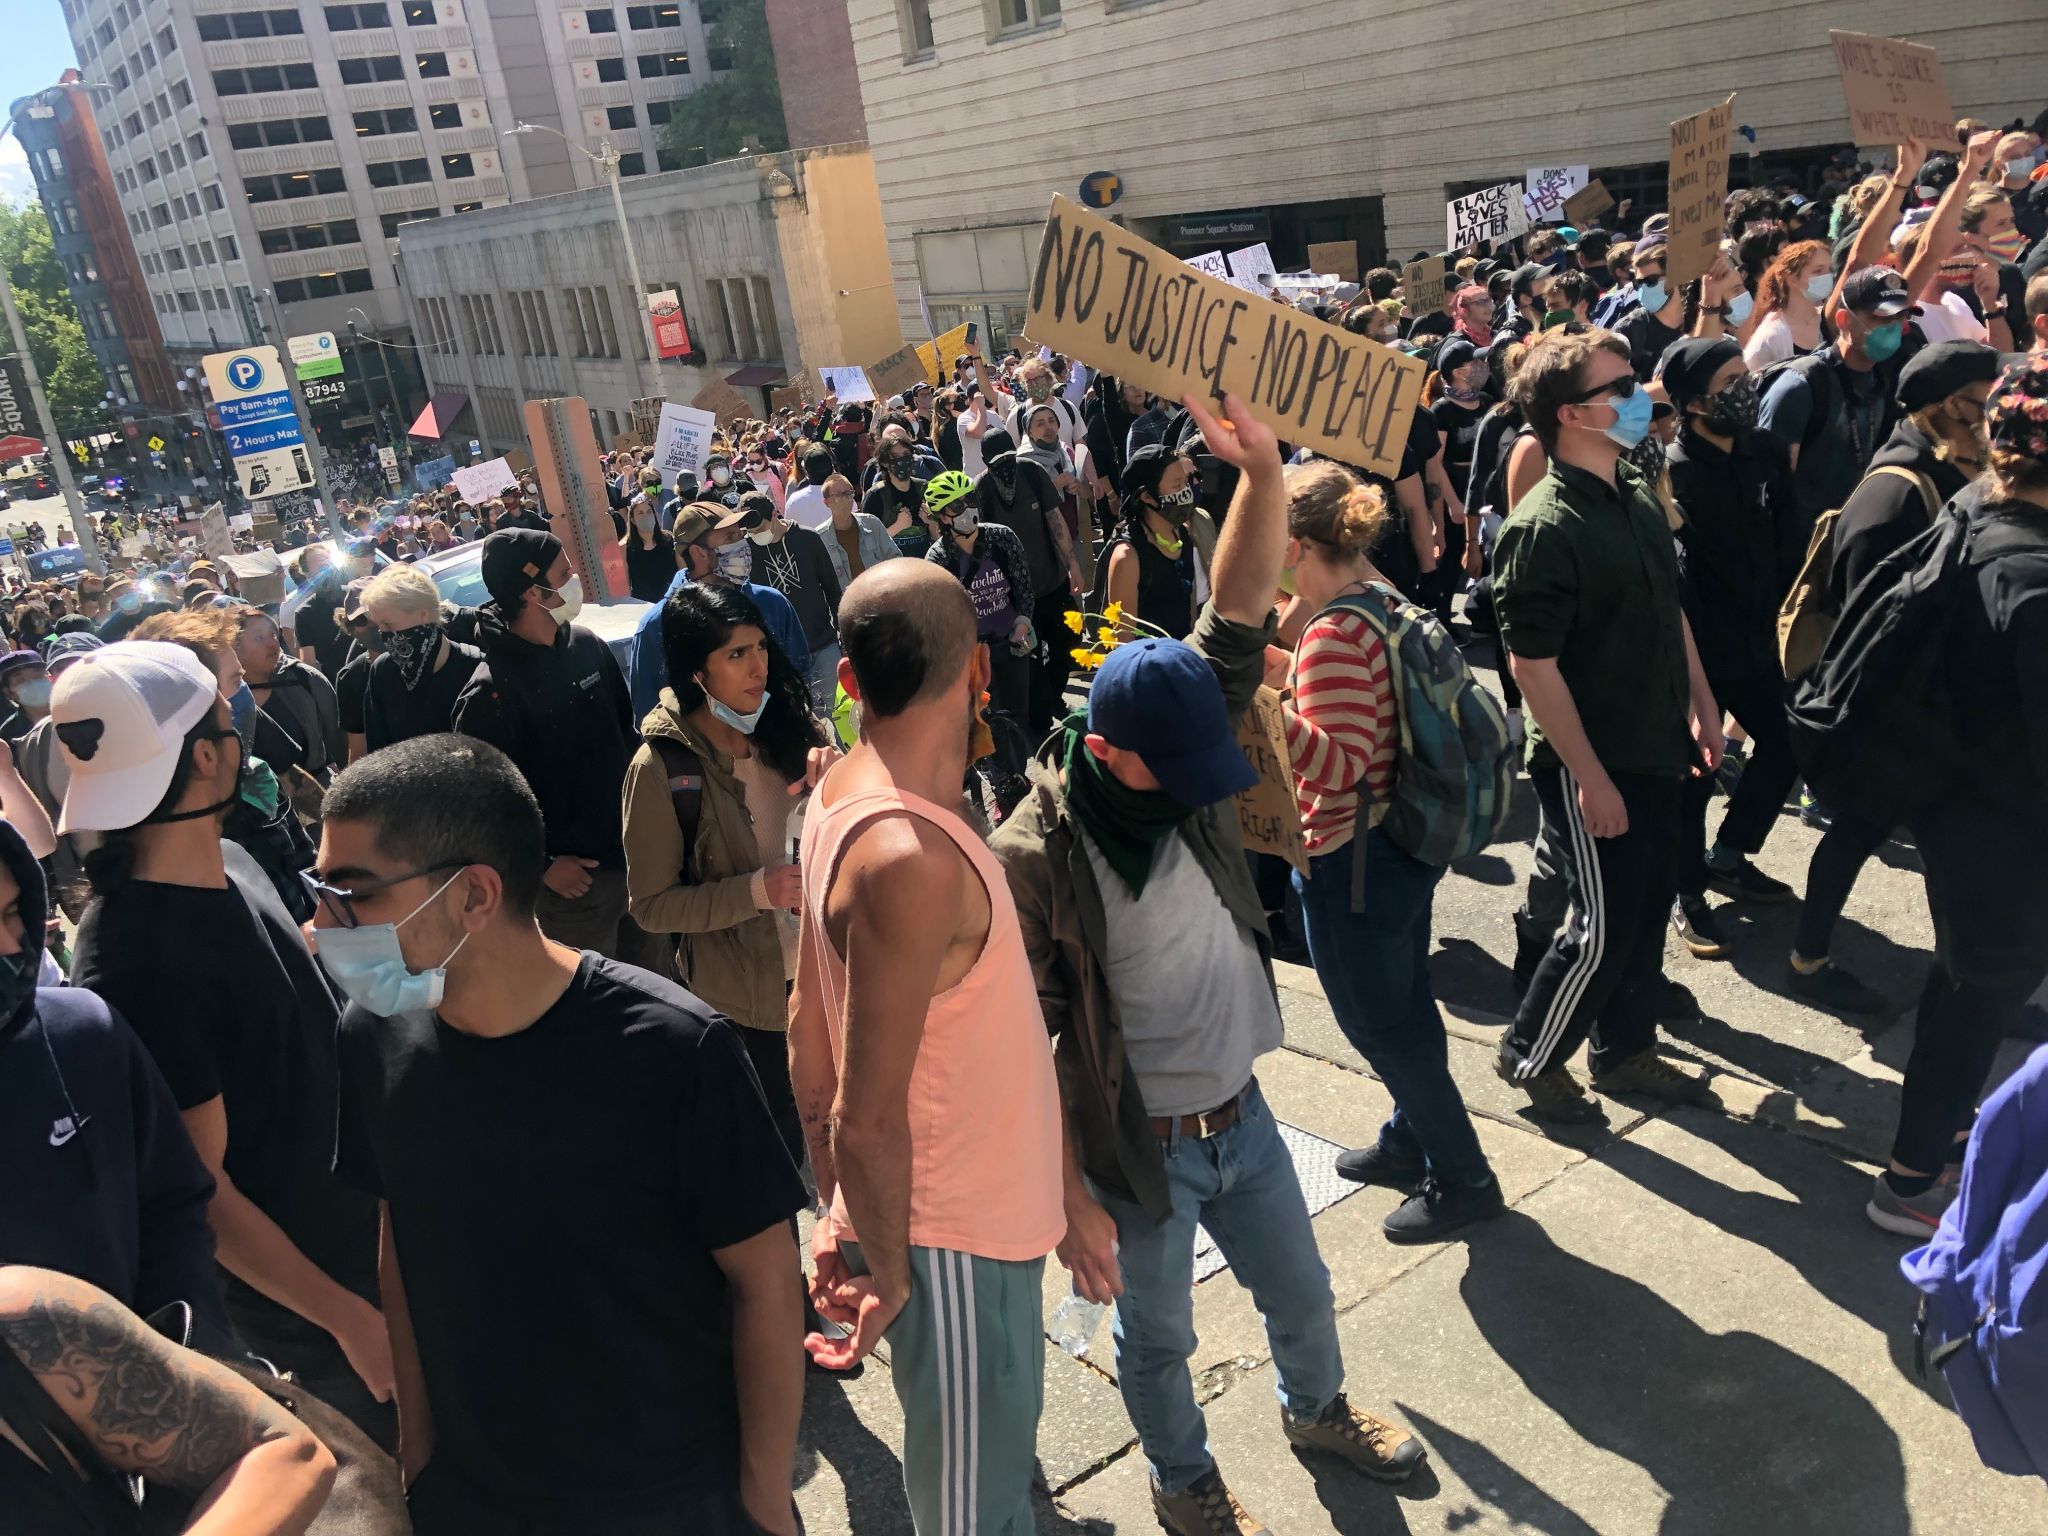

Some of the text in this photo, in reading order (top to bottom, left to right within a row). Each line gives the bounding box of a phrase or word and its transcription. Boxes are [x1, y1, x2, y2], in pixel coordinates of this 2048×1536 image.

[1886, 82, 1907, 103] IS
[1672, 116, 1698, 149] NOT
[1673, 171, 1699, 193] UNTIL
[1453, 185, 1507, 215] BLACK
[1180, 223, 1254, 236] Pioneer Square Station
[1455, 215, 1508, 249] MATTER
[1412, 265, 1423, 281] NO
[1412, 277, 1443, 299] JUSTICE
[1033, 214, 1103, 324] NO
[1104, 247, 1248, 401] JUSTICE
[1298, 333, 1415, 462] PEACE
[236, 363, 255, 385] P
[873, 350, 904, 377] BLACK
[305, 381, 346, 398] 87943
[220, 396, 288, 415] Pay 8am-6pm
[230, 428, 298, 449] 2 Hours Max
[285, 503, 310, 520] ACAB
